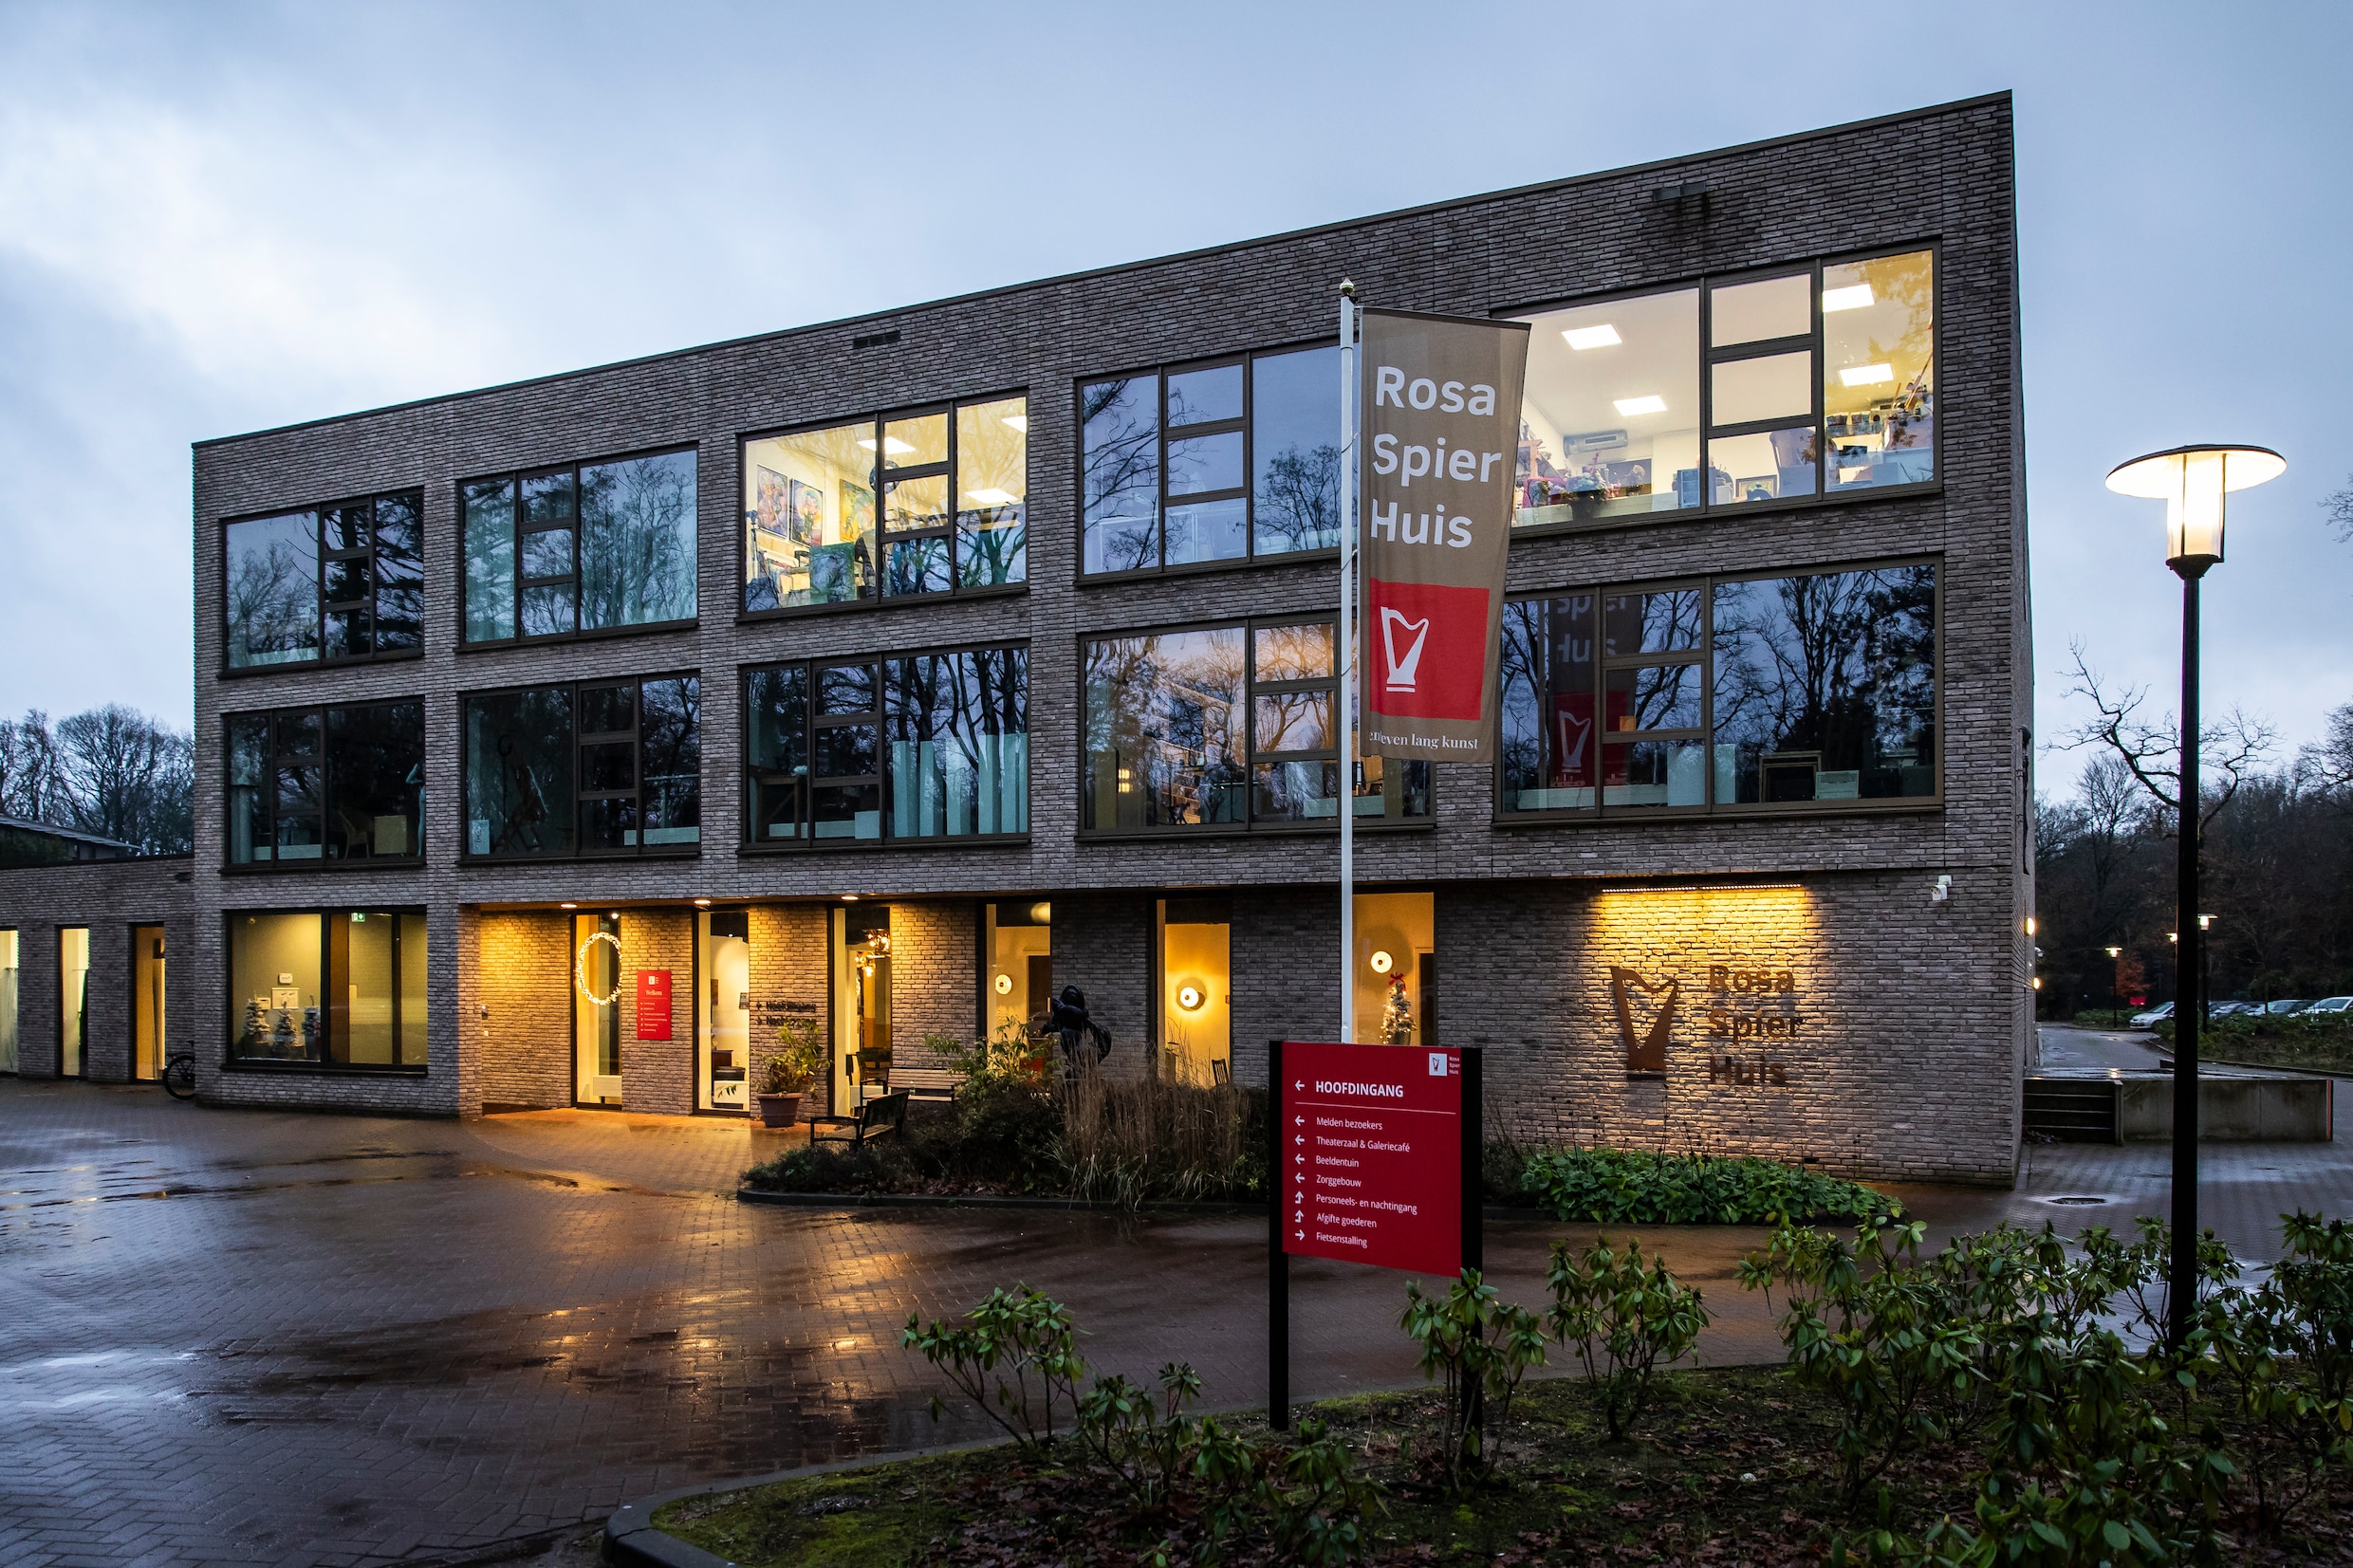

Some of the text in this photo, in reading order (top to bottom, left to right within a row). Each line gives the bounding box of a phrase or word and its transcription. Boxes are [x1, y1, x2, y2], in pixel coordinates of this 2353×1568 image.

[1376, 365, 1496, 416] Rosa
[1373, 433, 1502, 488] Spier
[1371, 498, 1473, 548] Huis
[1412, 733, 1439, 749] lang
[1442, 735, 1478, 749] kunst
[1709, 965, 1795, 993] Rosa
[1708, 1008, 1804, 1044] Spier
[1710, 1055, 1787, 1084] Huis
[1315, 1080, 1404, 1098] HOOFDINGANG
[1316, 1116, 1383, 1130] Melden bezoekers
[1316, 1135, 1411, 1153] Theaterzaal & Galeriecafé
[1315, 1154, 1360, 1168] Beeldentuin
[1316, 1174, 1362, 1188] Zorggebouw
[1316, 1193, 1417, 1215] Personeels- en nachtingang
[1316, 1212, 1378, 1227] Afgifte goederen
[1316, 1231, 1368, 1248] Fietsenstalling
